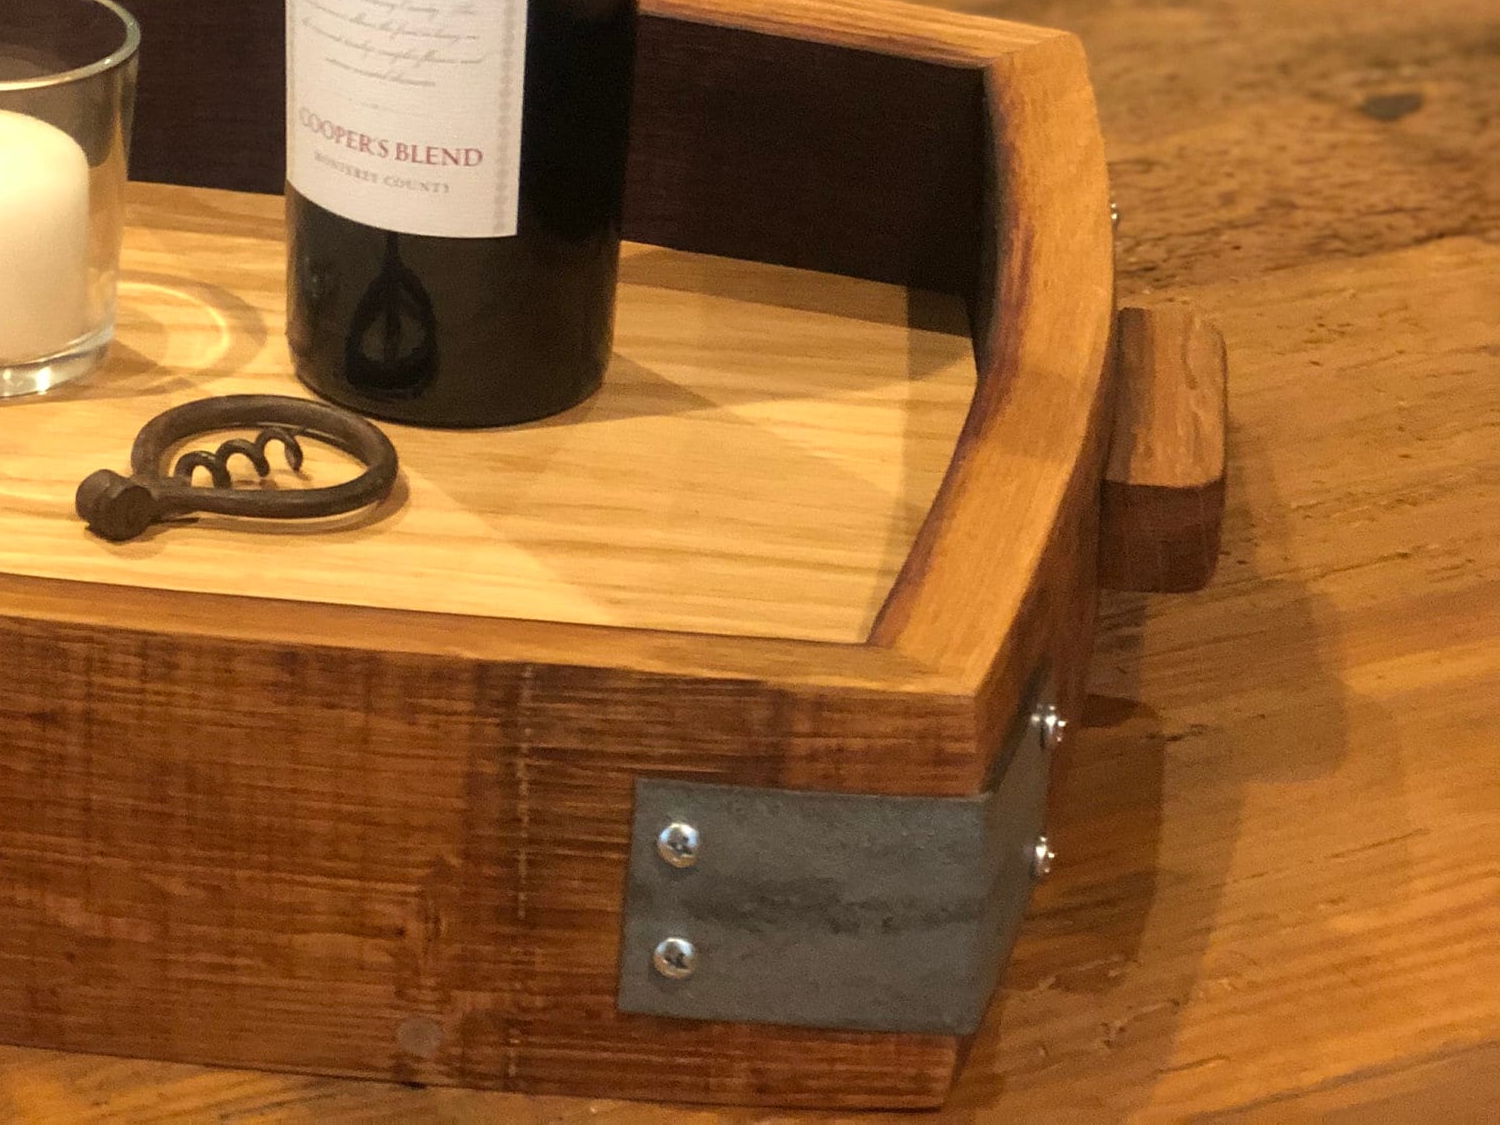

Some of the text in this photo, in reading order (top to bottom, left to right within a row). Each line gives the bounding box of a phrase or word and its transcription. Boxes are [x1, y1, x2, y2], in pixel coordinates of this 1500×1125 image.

[299, 106, 484, 168] COOPER'S BLEND
[383, 175, 450, 194] COUNTY
